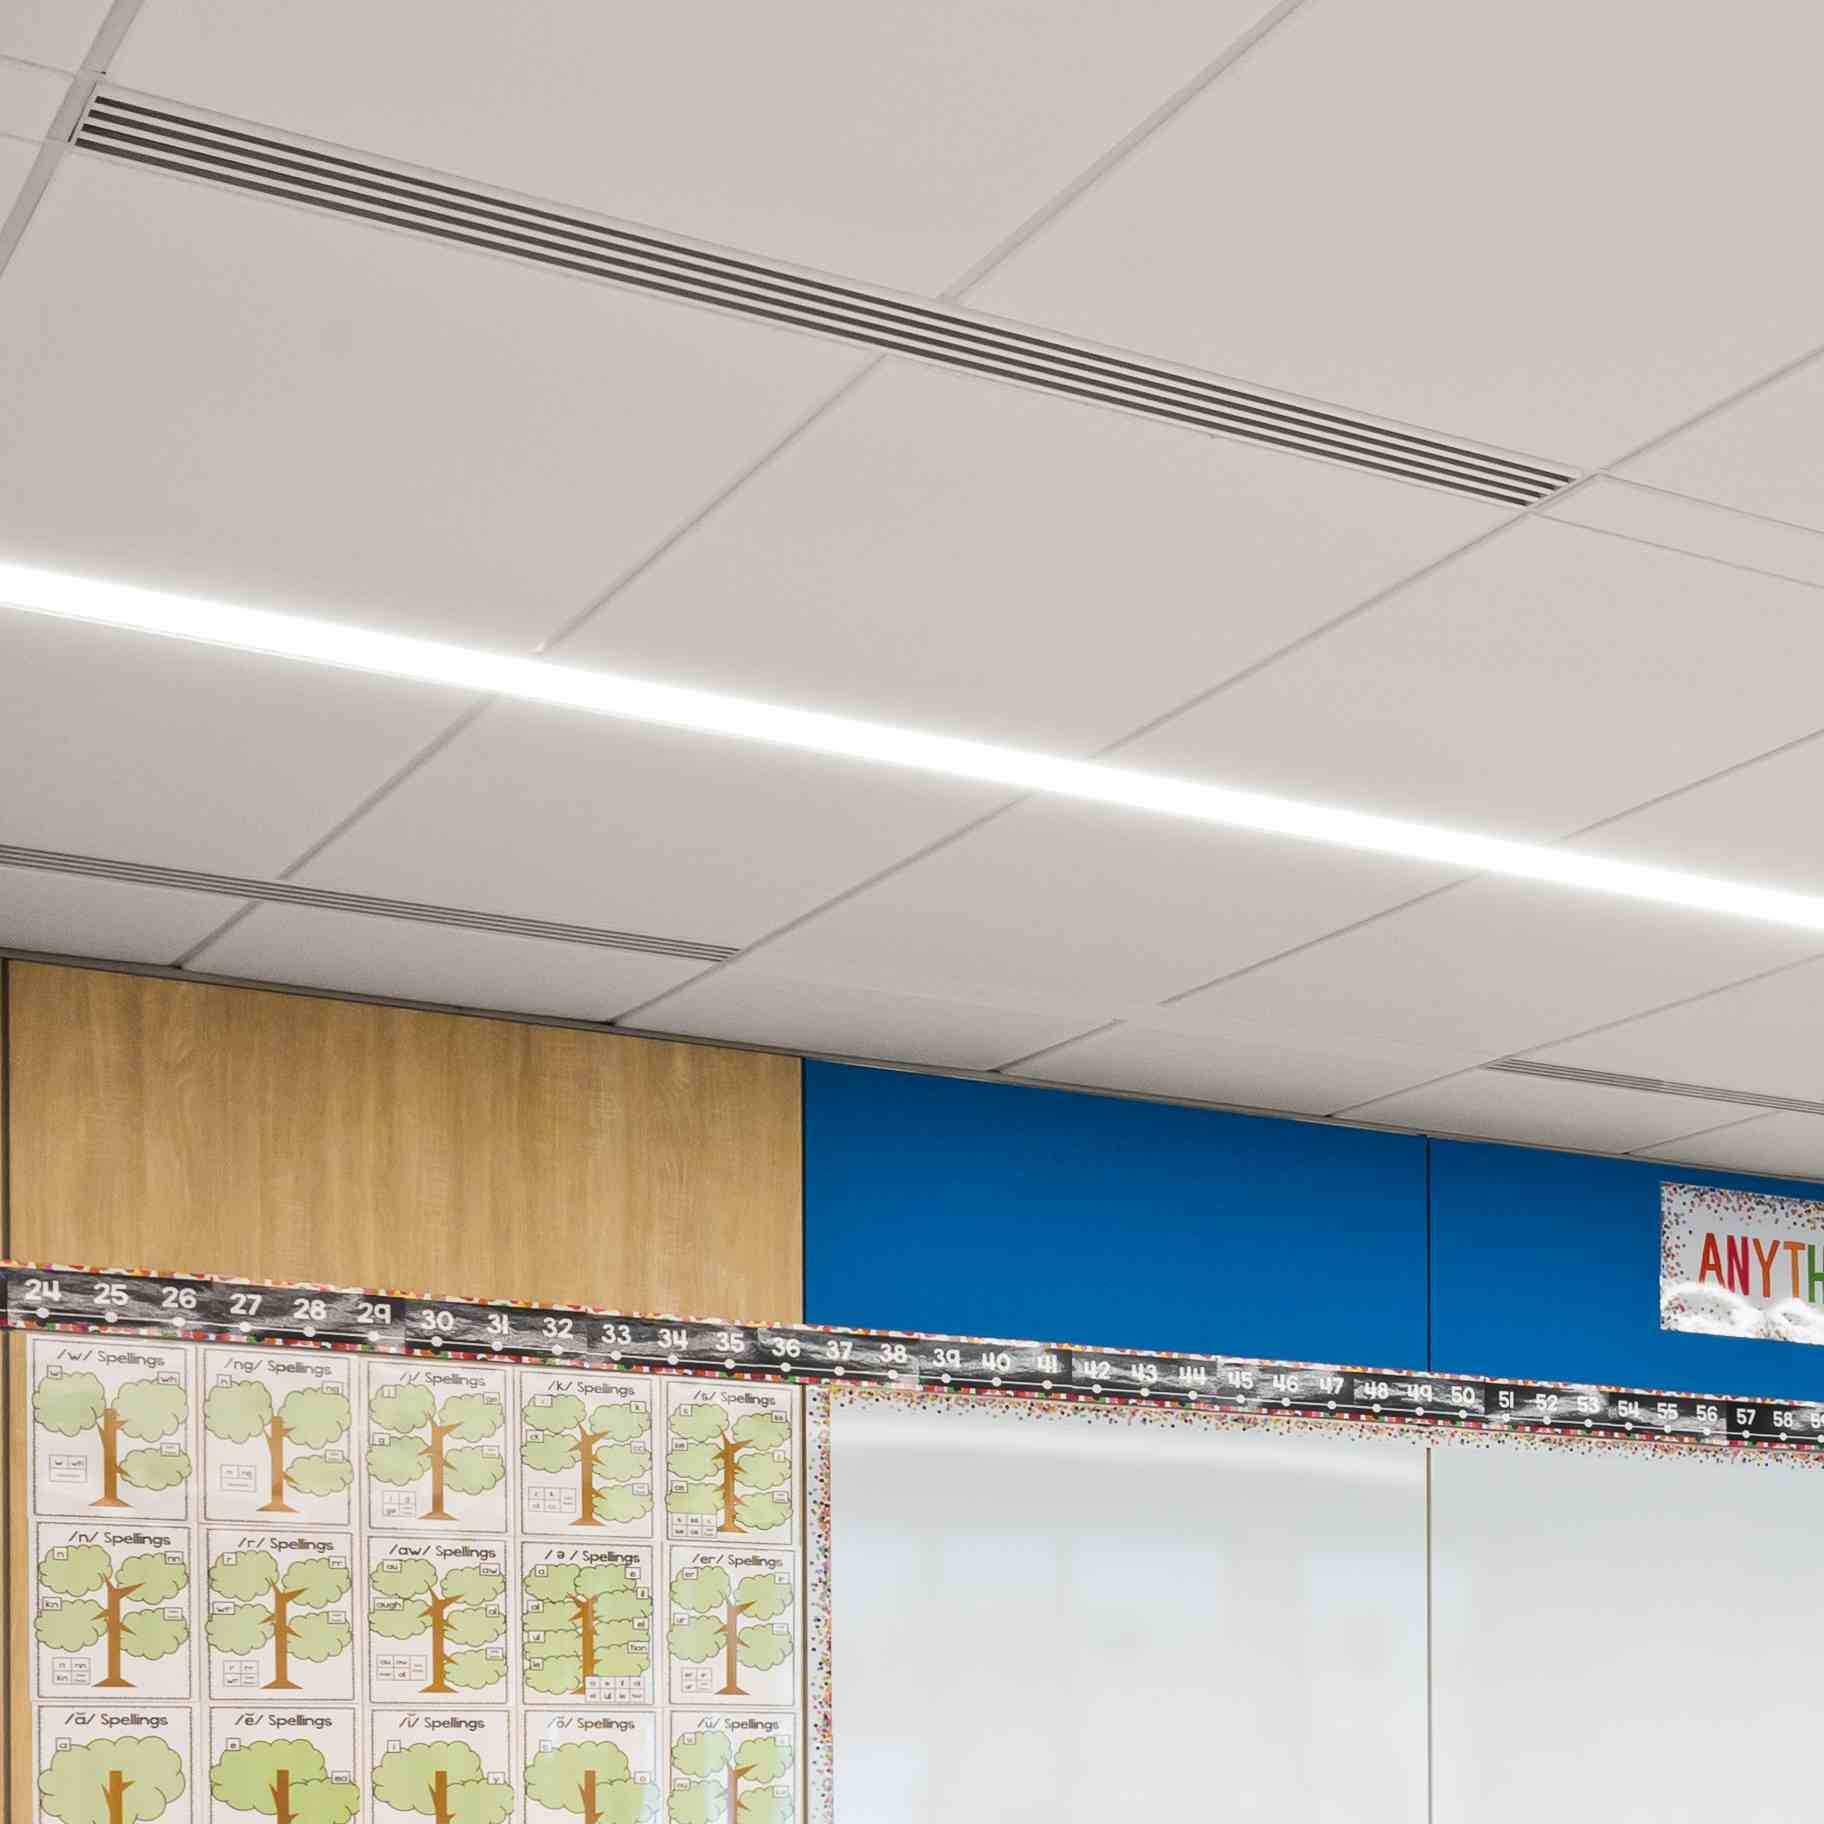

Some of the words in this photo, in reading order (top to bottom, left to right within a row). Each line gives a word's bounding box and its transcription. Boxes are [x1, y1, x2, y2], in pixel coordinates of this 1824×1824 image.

[24, 1279, 62, 1302] 24
[94, 1283, 129, 1305] 25
[162, 1287, 196, 1308] 26
[230, 1293, 262, 1314] 27
[294, 1299, 325, 1320] 28
[357, 1302, 391, 1323] 29
[423, 1311, 453, 1331] 30
[488, 1315, 509, 1334] 31
[543, 1318, 573, 1339] 32
[603, 1325, 631, 1344] 33
[657, 1329, 688, 1351] 34
[715, 1332, 745, 1353] 35
[772, 1338, 801, 1357] 36
[826, 1341, 852, 1360] 37
[880, 1344, 907, 1363] 38
[933, 1349, 960, 1368] 39
[1451, 1387, 1475, 1404] 50
[1498, 1391, 1514, 1409] 51
[1618, 1401, 1639, 1418] 54
[1657, 1403, 1678, 1419] 55
[1697, 1405, 1718, 1422] 56
[1737, 1409, 1755, 1424] 57
[1774, 1411, 1793, 1427] 58
[57, 1349, 92, 1361] /w/
[100, 1350, 166, 1370] Spellings
[224, 1358, 263, 1375] /ng/
[268, 1360, 333, 1377] Spellings
[548, 1381, 573, 1392] /k/
[577, 1382, 635, 1397] Spellings
[69, 1531, 98, 1544] /n/
[104, 1532, 172, 1548] Spellings
[270, 1539, 335, 1554] Spellings
[389, 1544, 432, 1556] /aw/
[435, 1545, 497, 1561] Spellings
[728, 1554, 784, 1571] Spellings
[100, 1713, 169, 1730] Spellings
[268, 1714, 334, 1730] Spellings
